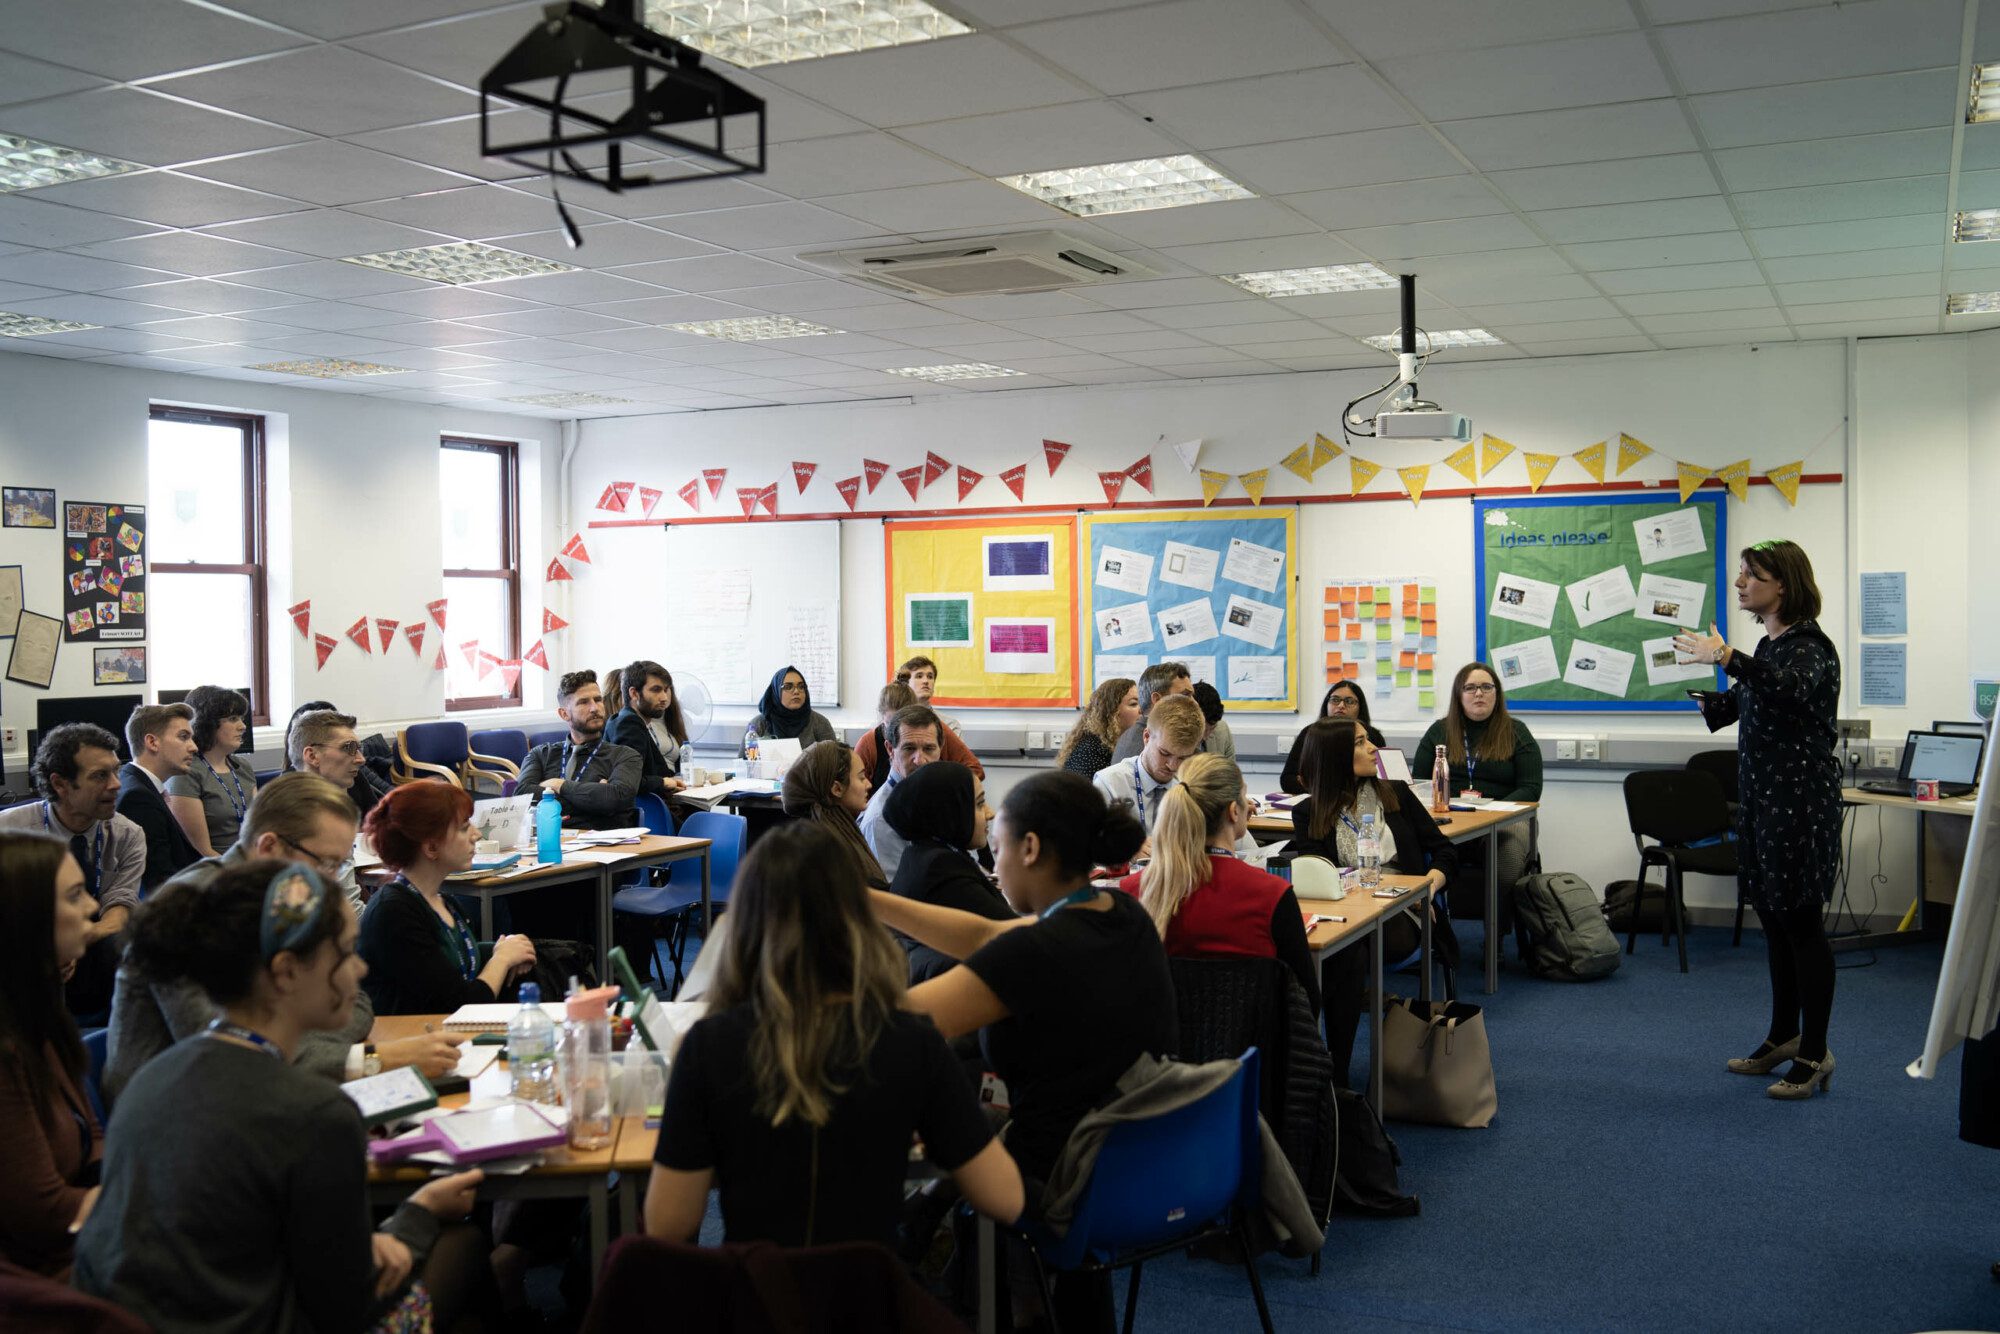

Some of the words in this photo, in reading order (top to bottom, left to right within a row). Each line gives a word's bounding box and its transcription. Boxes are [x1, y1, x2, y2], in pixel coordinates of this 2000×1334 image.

[1583, 452, 1601, 463] once
[795, 467, 812, 477] safely
[865, 466, 885, 477] quickly
[1130, 464, 1151, 478] wildly
[960, 475, 976, 485] well
[1103, 477, 1121, 487] shyly
[840, 484, 857, 492] sadly
[1500, 532, 1545, 548] Ideas
[1552, 530, 1608, 547] please
[490, 806, 508, 814] Table
